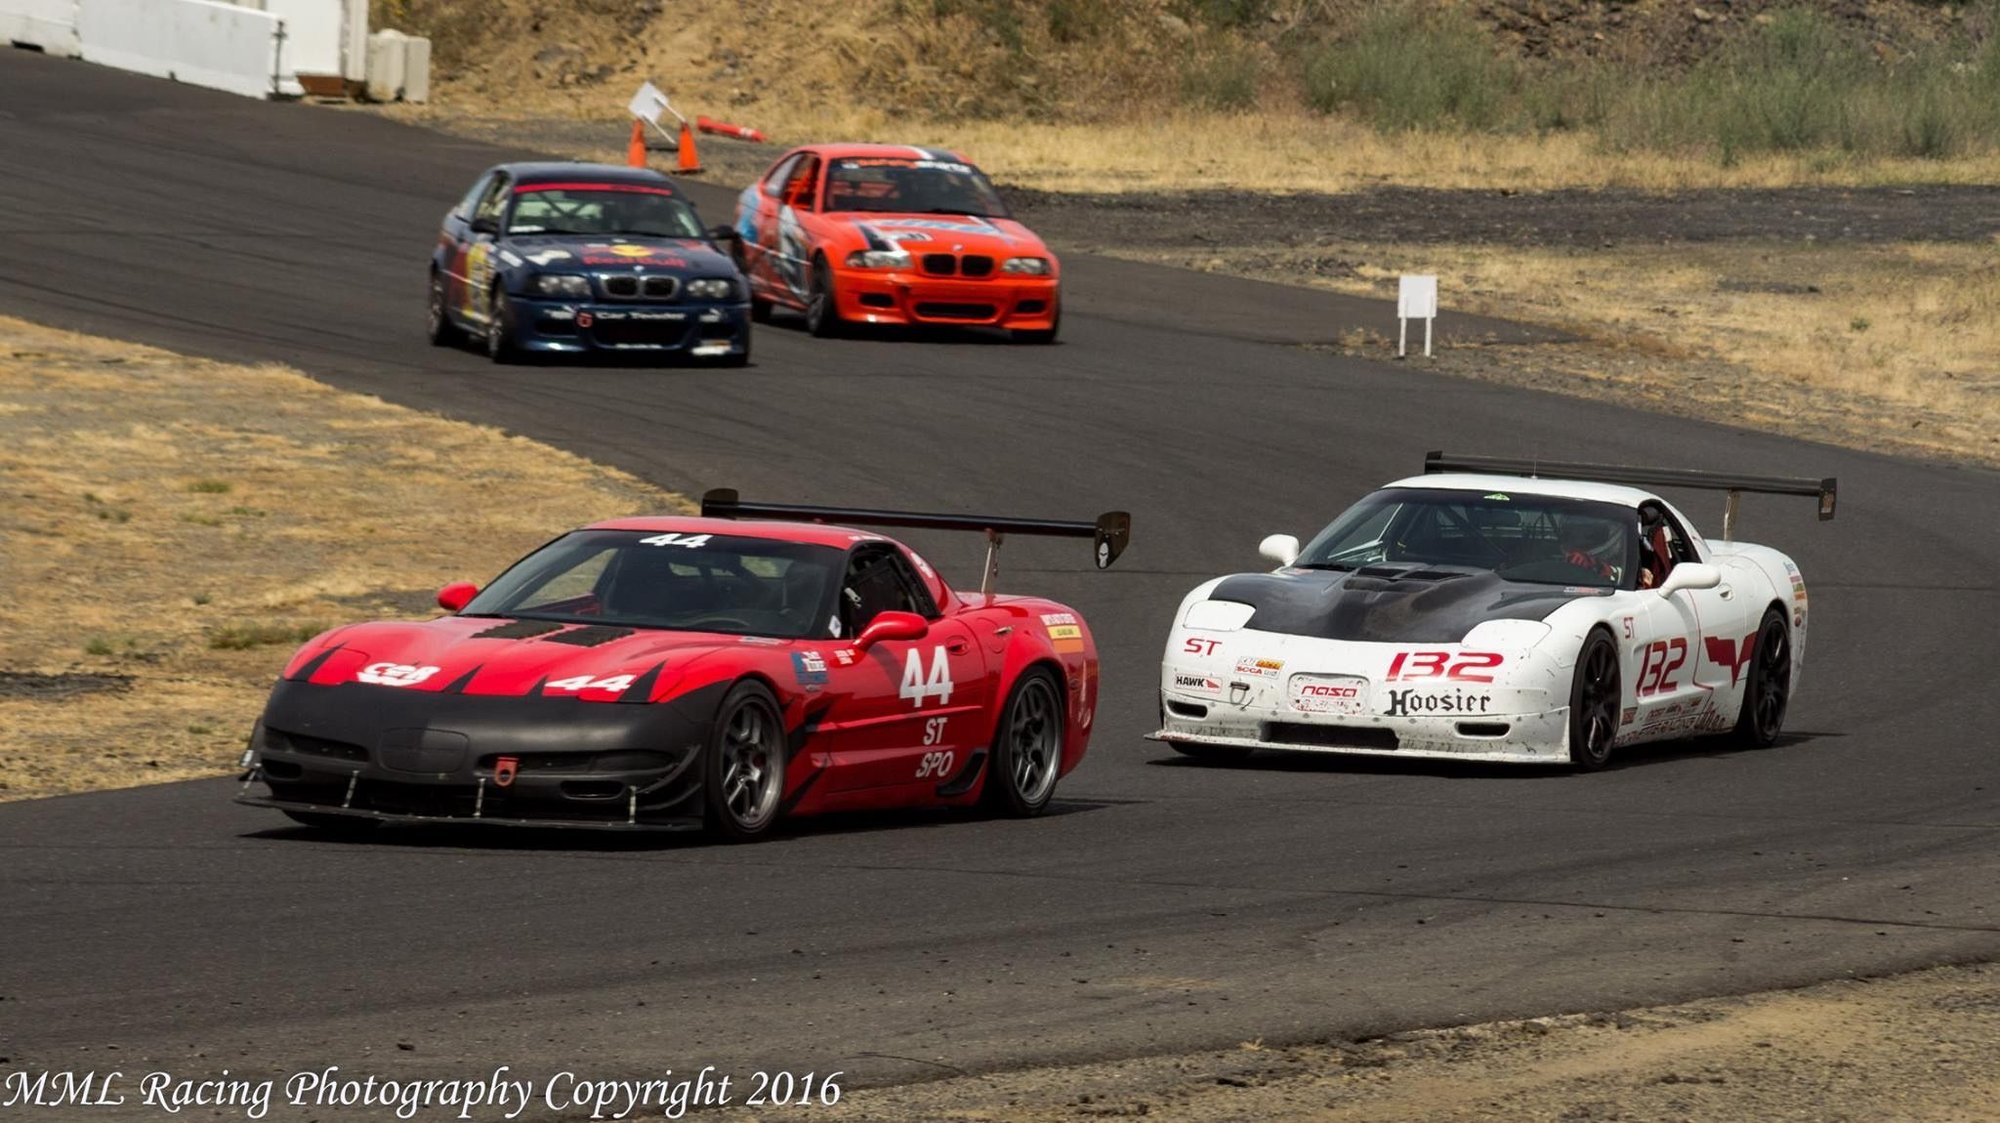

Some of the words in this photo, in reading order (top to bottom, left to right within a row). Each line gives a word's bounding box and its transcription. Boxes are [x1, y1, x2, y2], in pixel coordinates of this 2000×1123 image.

[639, 533, 714, 548] 44
[1624, 616, 1635, 639] ST
[1184, 637, 1222, 656] ST
[900, 645, 954, 708] 44
[1384, 652, 1505, 683] 132
[1636, 637, 1688, 697] 132
[545, 675, 638, 692] 44
[1176, 676, 1205, 688] HAWK
[1384, 688, 1492, 716] Hoosier
[923, 717, 948, 746] ST
[915, 751, 954, 778] SPO
